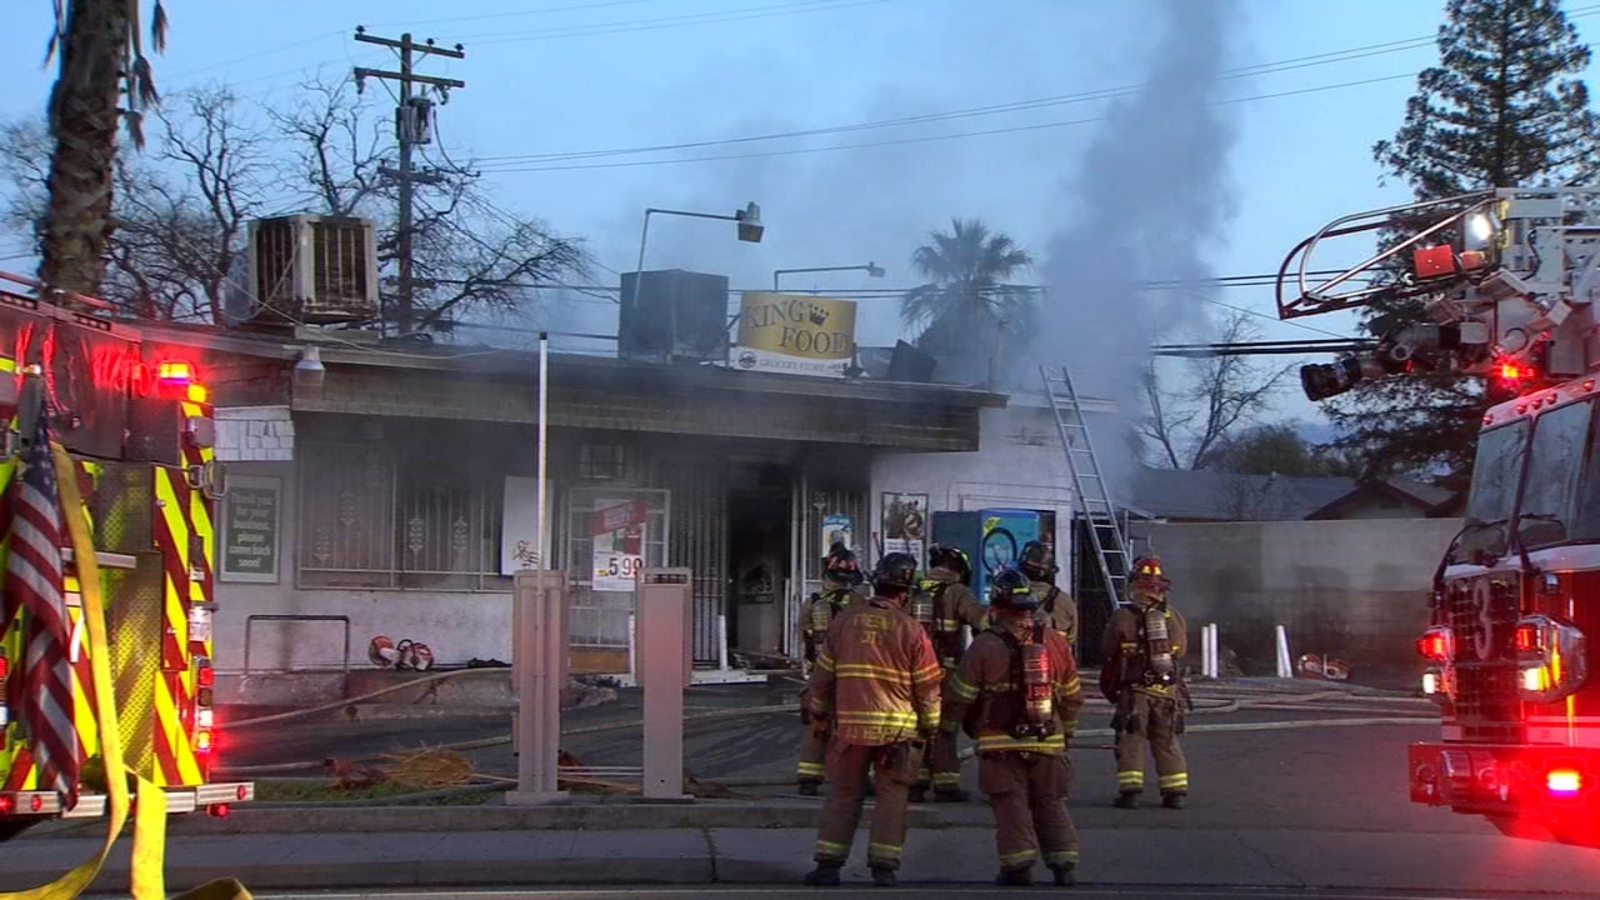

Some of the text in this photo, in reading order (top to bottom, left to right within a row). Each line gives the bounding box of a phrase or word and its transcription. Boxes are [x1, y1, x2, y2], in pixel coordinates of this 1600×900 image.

[745, 299, 804, 328] KING
[778, 325, 852, 354] FOOD
[229, 544, 271, 556] come back
[237, 531, 264, 545] please
[1473, 578, 1491, 660] 3
